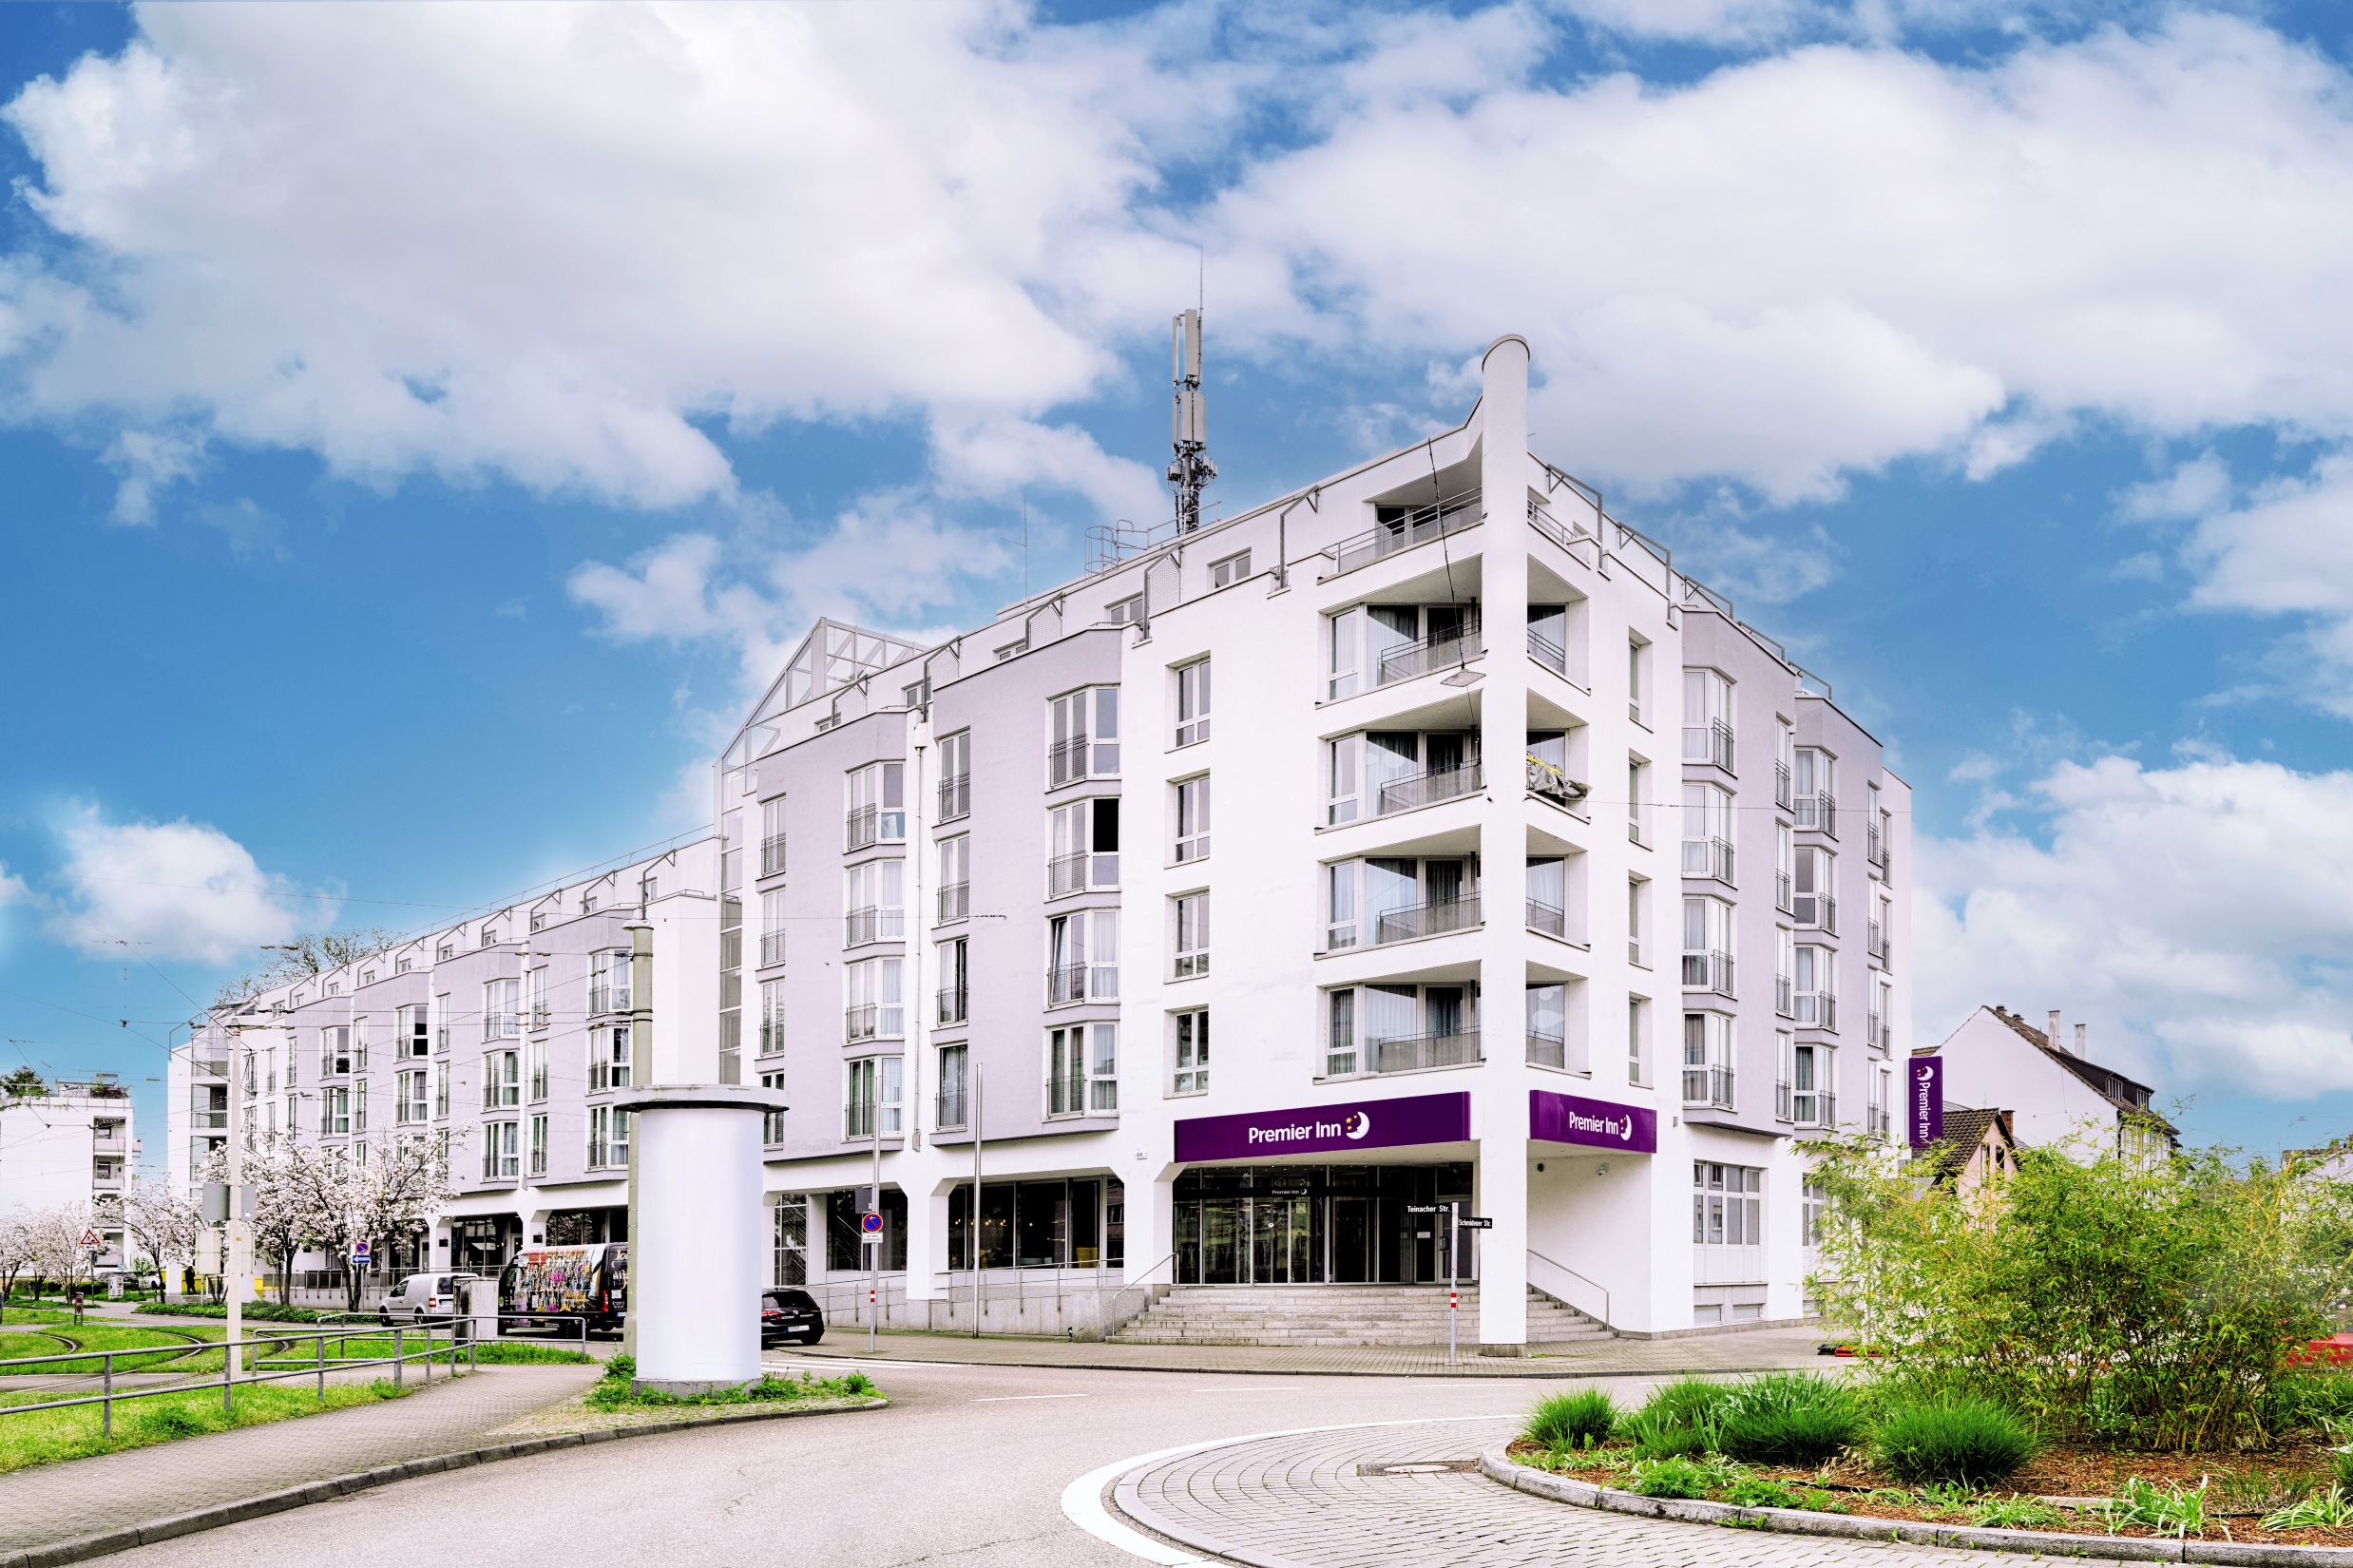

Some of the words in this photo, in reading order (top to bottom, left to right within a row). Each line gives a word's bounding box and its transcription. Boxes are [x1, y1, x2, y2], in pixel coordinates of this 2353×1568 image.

[1919, 1082, 1931, 1121] Premier
[1249, 1123, 1312, 1144] Premier
[1315, 1121, 1341, 1138] Inn
[1569, 1111, 1604, 1133] Premier
[1605, 1117, 1618, 1136] Inn
[1919, 1122, 1931, 1138] Inn
[1458, 1218, 1483, 1227] Schmidener
